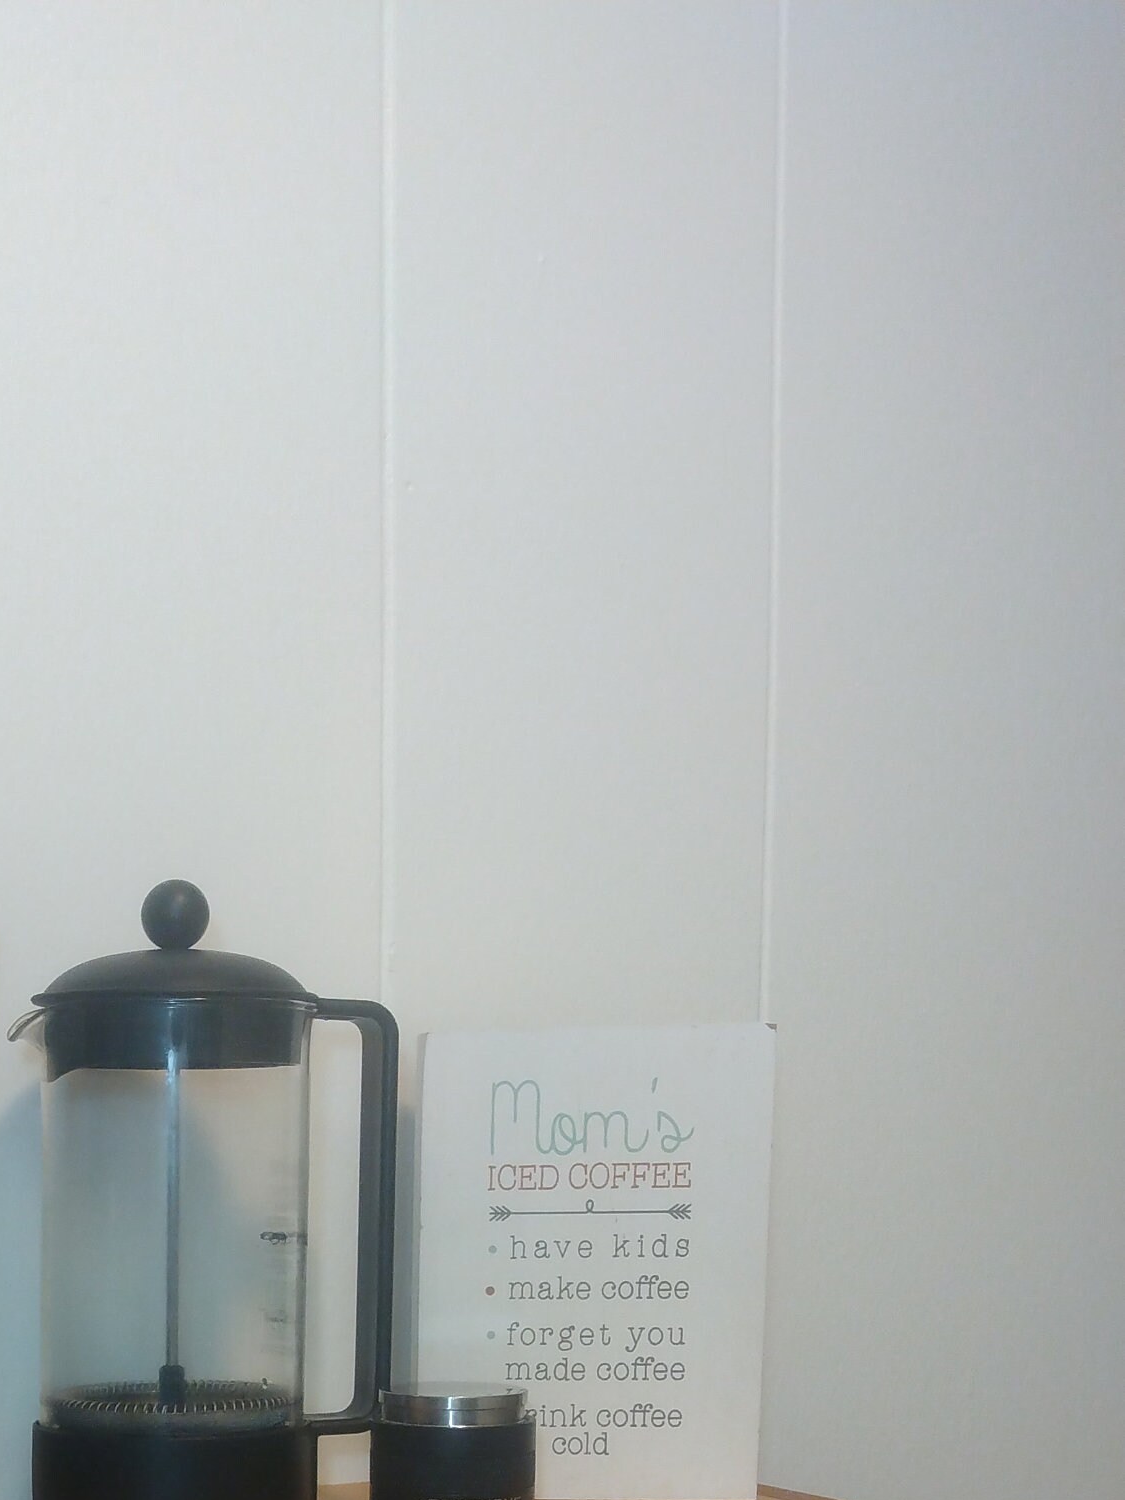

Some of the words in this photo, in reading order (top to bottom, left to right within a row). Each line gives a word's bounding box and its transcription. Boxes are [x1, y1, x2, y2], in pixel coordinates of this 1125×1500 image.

[489, 1077, 695, 1157] Mom's
[487, 1164, 560, 1191] ICED
[568, 1162, 692, 1190] COFFEE
[509, 1235, 594, 1261] have
[612, 1234, 691, 1259] kids
[508, 1276, 592, 1301] make
[601, 1275, 690, 1300] coffee
[506, 1323, 612, 1352] forget
[625, 1328, 687, 1353] you
[505, 1358, 586, 1382] made
[596, 1357, 686, 1381] coffee
[524, 1403, 588, 1429] rink
[596, 1403, 683, 1428] coffee
[551, 1432, 610, 1456] cold
